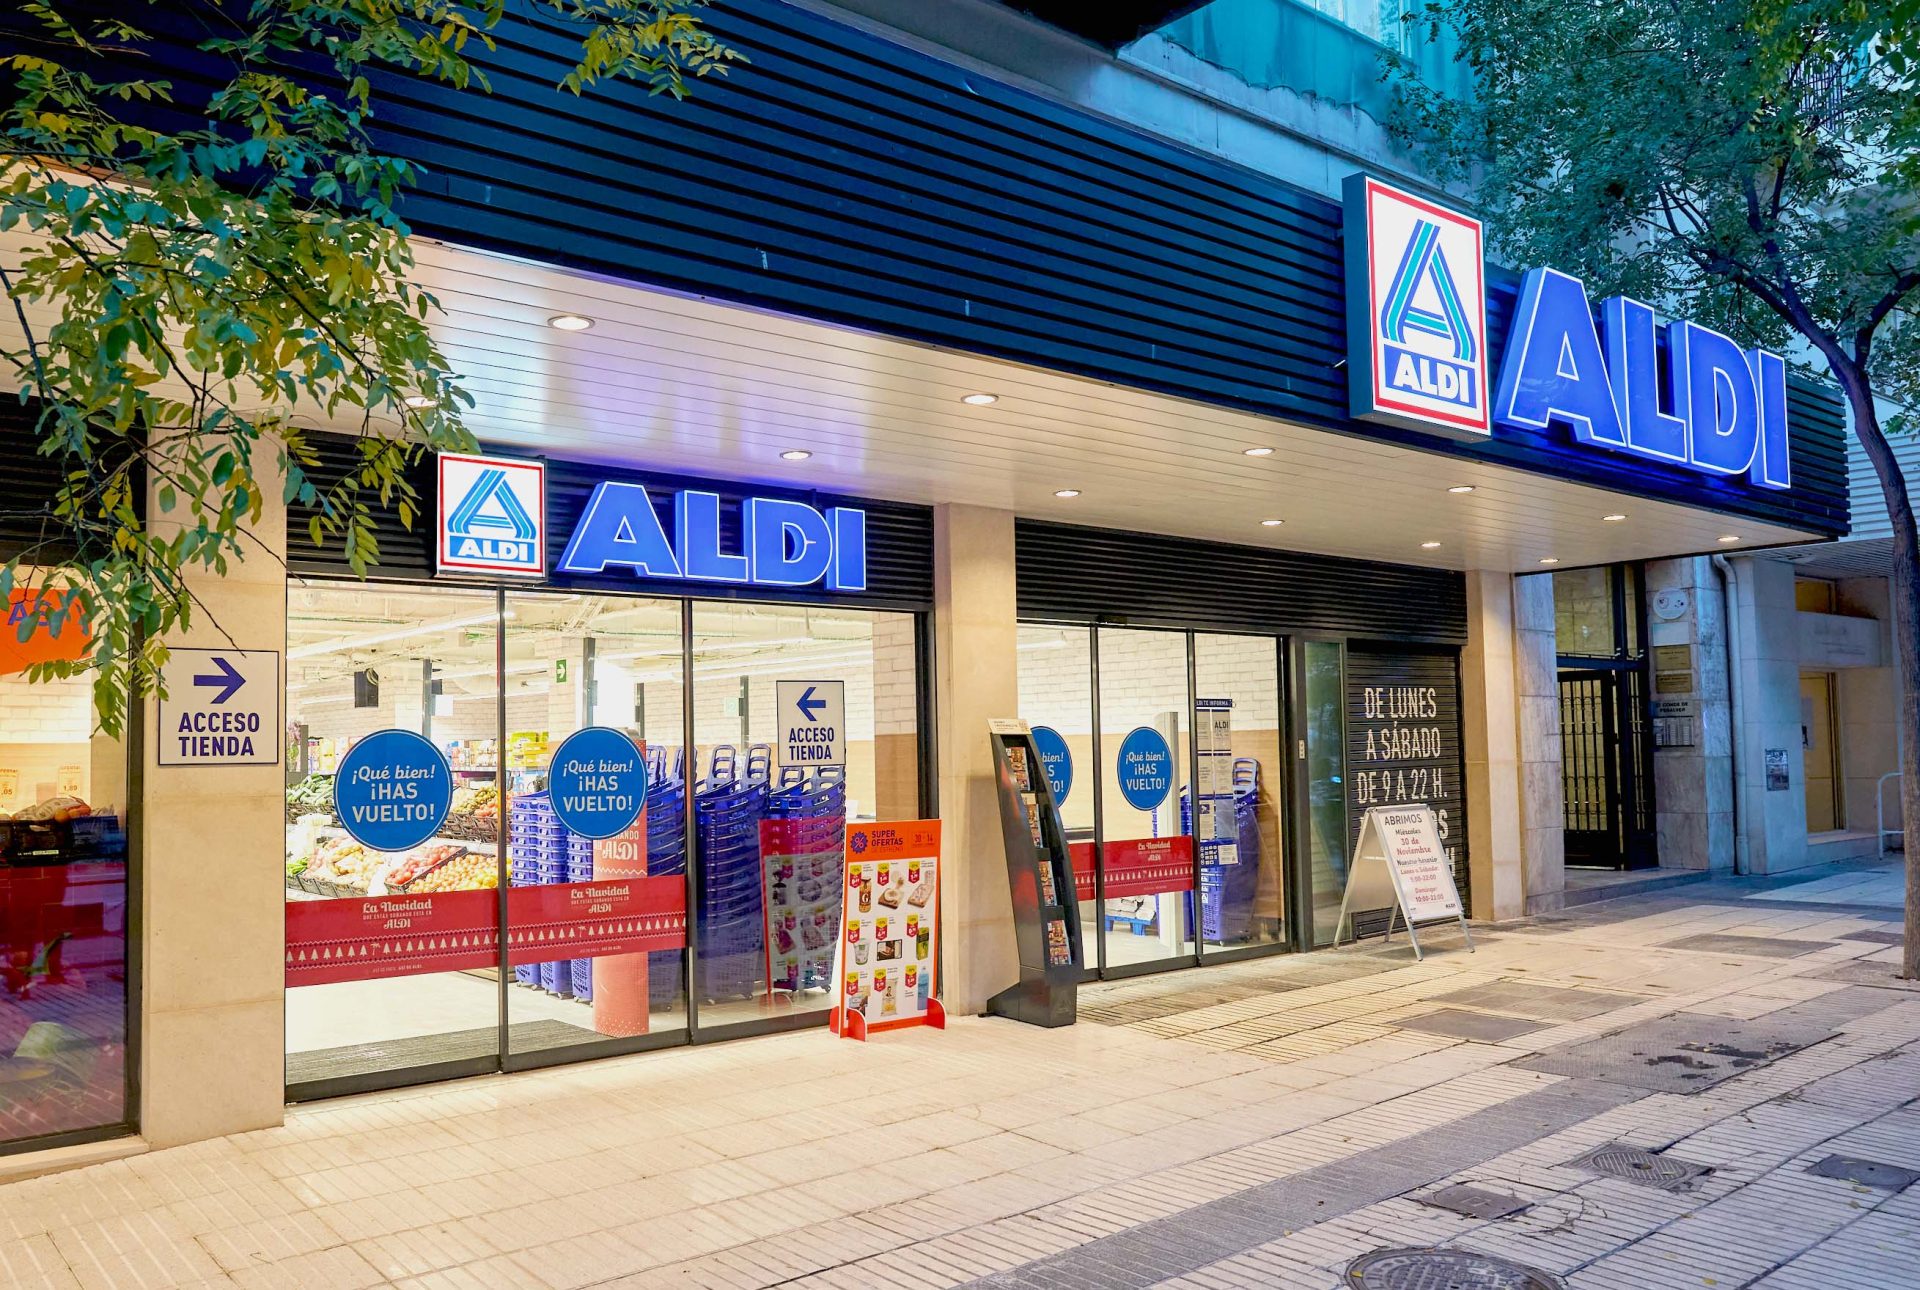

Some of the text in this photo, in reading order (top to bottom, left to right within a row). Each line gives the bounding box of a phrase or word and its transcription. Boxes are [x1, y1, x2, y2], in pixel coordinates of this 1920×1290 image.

[1394, 353, 1469, 403] ALDI
[1497, 266, 1791, 489] ALDI
[558, 480, 867, 591] ALDI
[458, 538, 528, 560] ALDI
[1365, 688, 1436, 718] DE LUNES
[178, 712, 260, 733] ACCESO
[1215, 721, 1228, 729] ALDI
[789, 727, 834, 743] ACCESO
[1367, 721, 1440, 760] A SÁBADO
[178, 736, 254, 757] TIENDA
[789, 745, 832, 760] TIENDA
[1126, 751, 1164, 764] ¡Qué bien!
[352, 764, 436, 784] ¡Qué bien!
[563, 760, 633, 777] ¡Qué bien!
[1134, 763, 1157, 775] ¡HAS
[371, 782, 418, 800] ¡HAS
[578, 776, 618, 791] ¡HAS
[1126, 778, 1165, 791] VUELTO!
[1358, 772, 1377, 803] DE
[1382, 771, 1390, 801] 9
[1397, 770, 1406, 800] A
[1410, 769, 1428, 799] 22
[563, 796, 633, 812] VUELTO!
[352, 804, 434, 823] VUELTO!
[1385, 814, 1422, 825] ABRIMOS
[872, 830, 895, 838] SUPER
[872, 838, 903, 846] OFERTAS
[602, 841, 638, 861] ALDI
[1397, 847, 1431, 855] Noviembre
[571, 885, 630, 898] La Navidad
[363, 899, 432, 914] La Navidad
[588, 903, 612, 913] ALDI
[384, 919, 411, 929] ALDI
